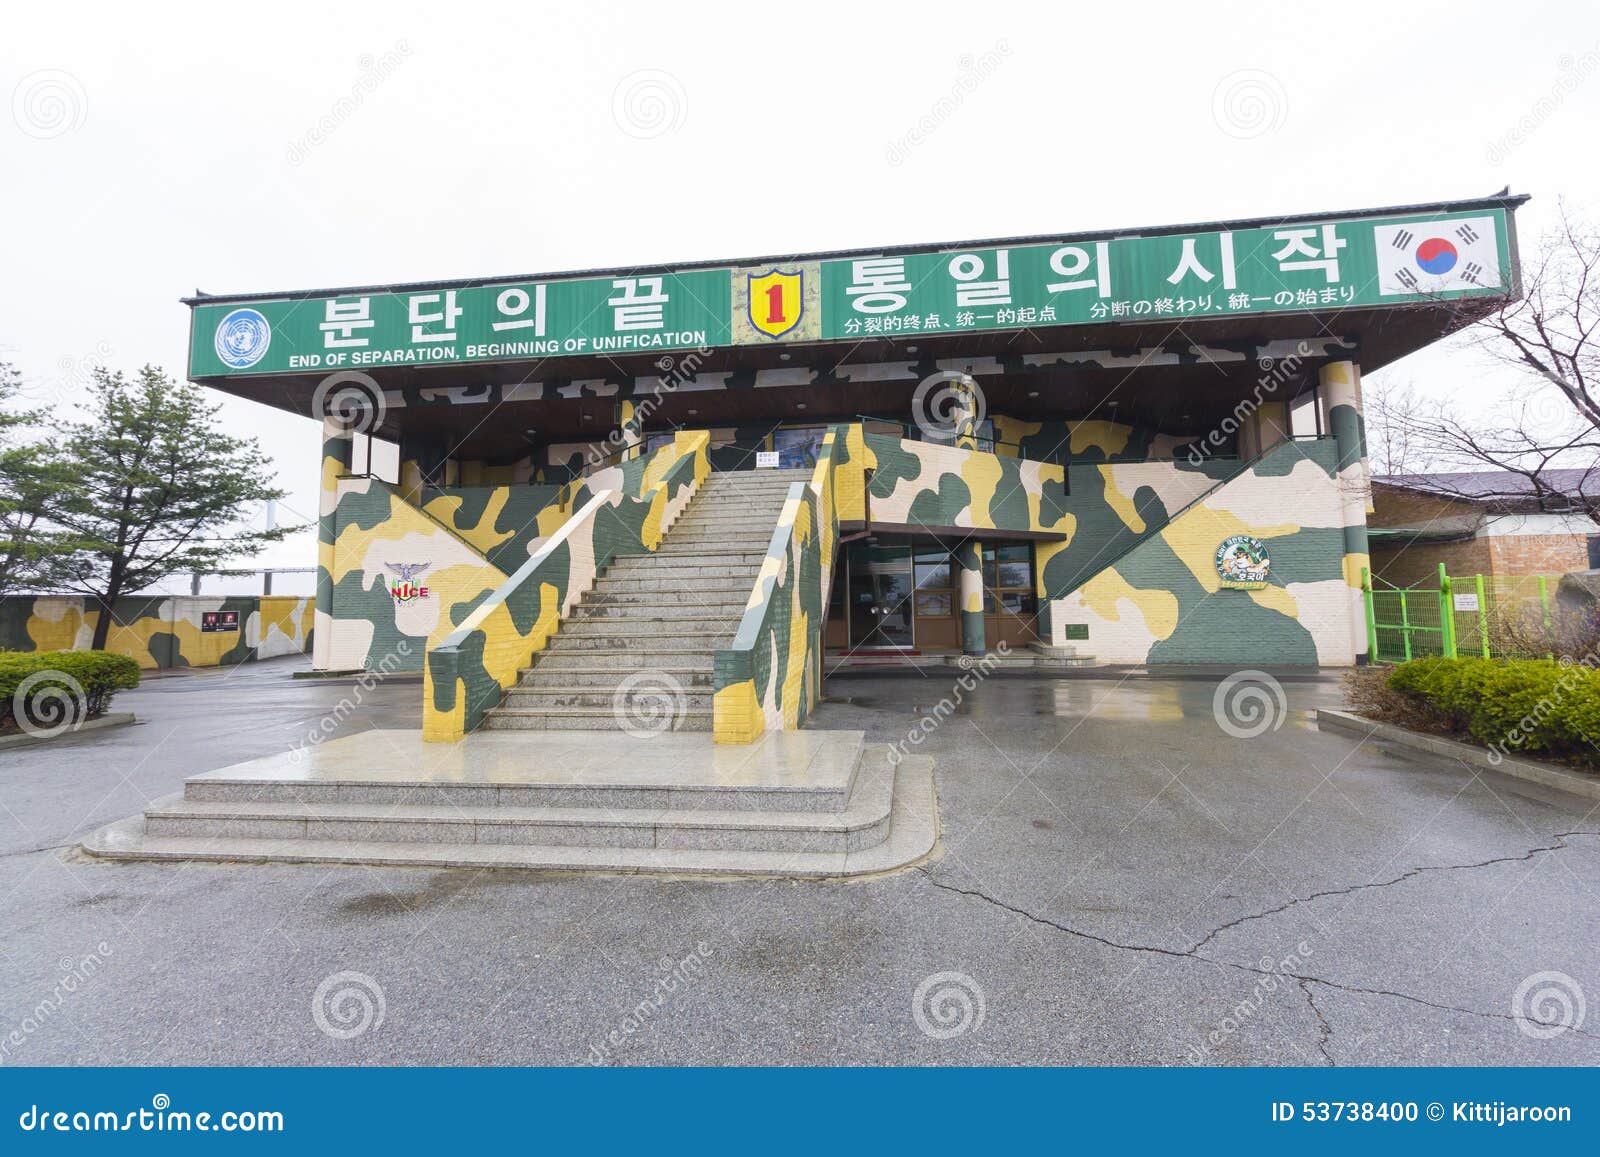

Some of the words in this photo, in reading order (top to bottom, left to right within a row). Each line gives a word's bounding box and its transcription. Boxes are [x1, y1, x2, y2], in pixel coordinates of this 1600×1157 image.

[846, 242, 1112, 313] 통일의
[1166, 224, 1347, 290] 시작
[319, 284, 548, 348] 분단의
[608, 277, 669, 331] 끝
[765, 284, 786, 324] 1
[289, 355, 321, 368] END
[325, 353, 347, 366] OF
[351, 347, 460, 364] SEPARATION,
[466, 340, 559, 358] BEGINNING
[564, 338, 588, 351] OF
[593, 330, 706, 350] UNIFICATION
